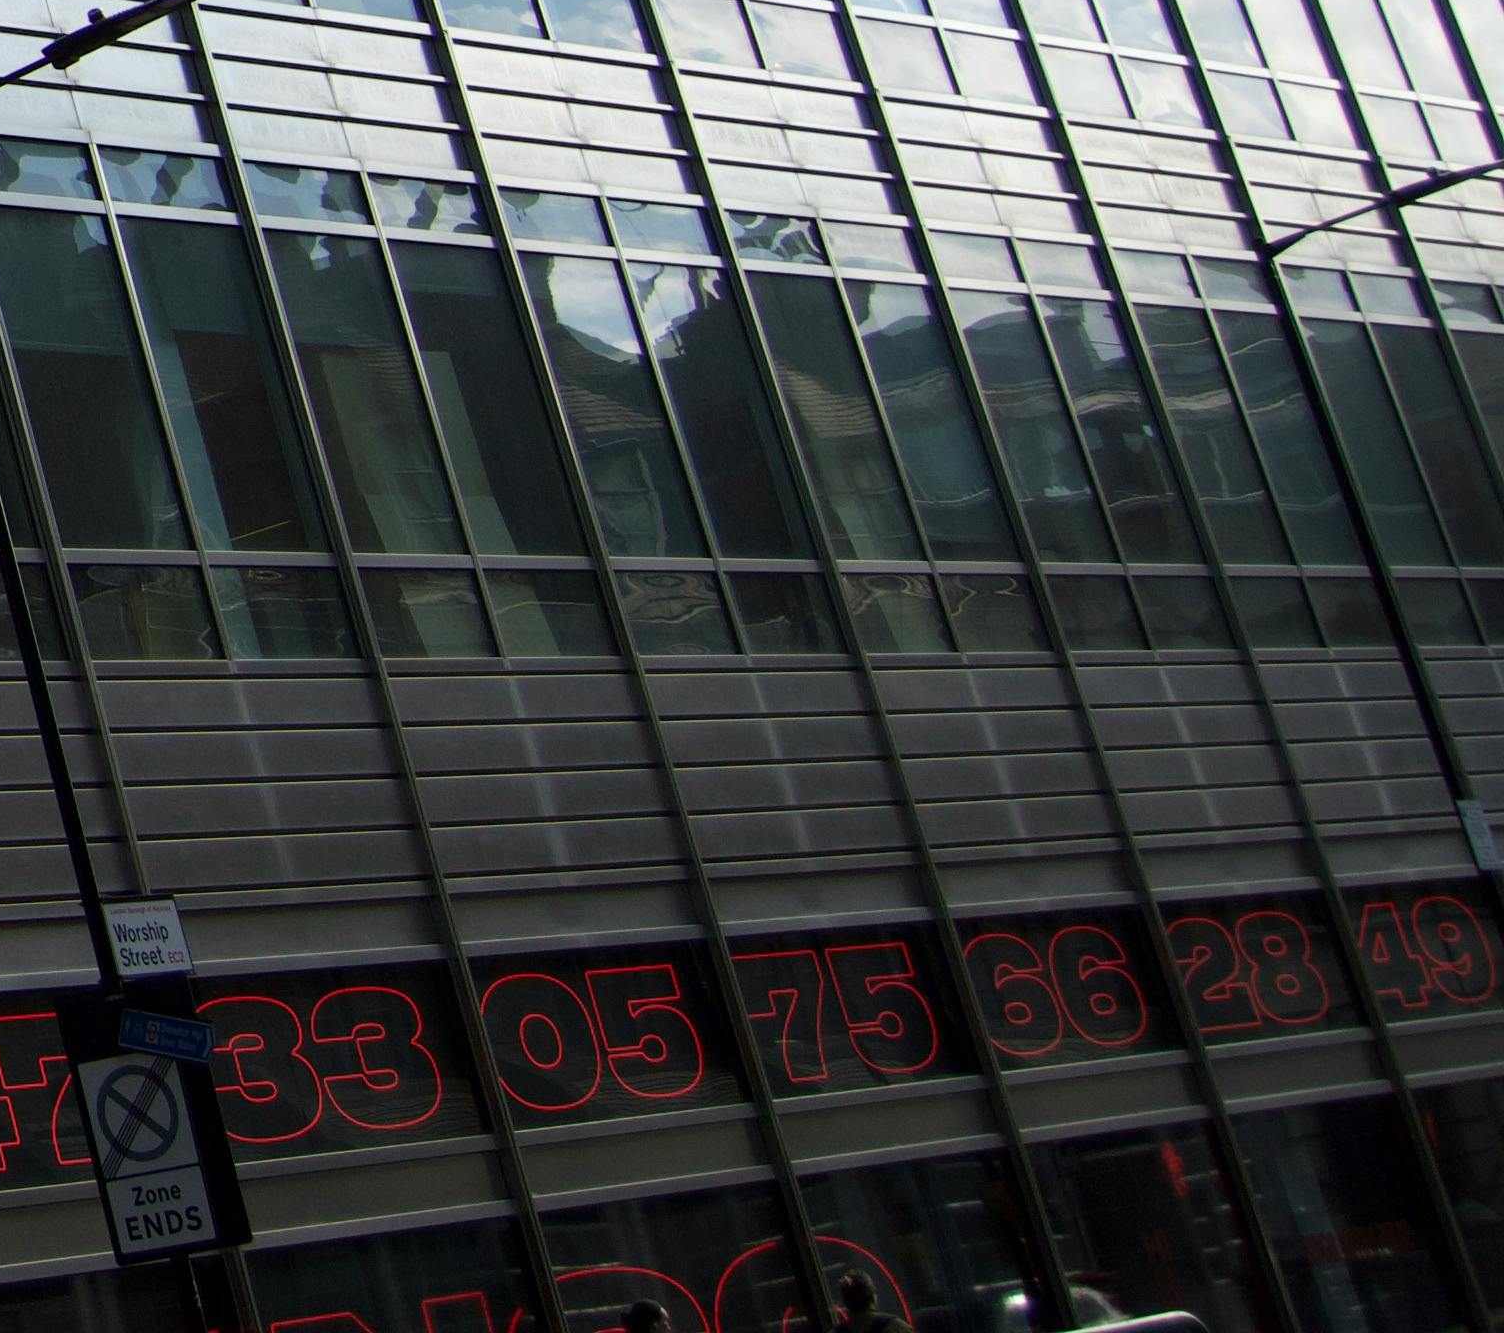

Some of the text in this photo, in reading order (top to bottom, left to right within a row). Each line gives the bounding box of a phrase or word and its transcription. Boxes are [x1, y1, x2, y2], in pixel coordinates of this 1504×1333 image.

[112, 921, 169, 944] Worship
[119, 945, 185, 967] Street EC2
[194, 984, 443, 1144] 33
[479, 963, 705, 1112] 05
[730, 940, 941, 1085] 75
[963, 925, 1148, 1058] 66
[1165, 910, 1329, 1034] 28
[1359, 894, 1498, 1009] 49
[131, 1184, 182, 1206] Zone
[124, 1205, 204, 1241] ENDS
